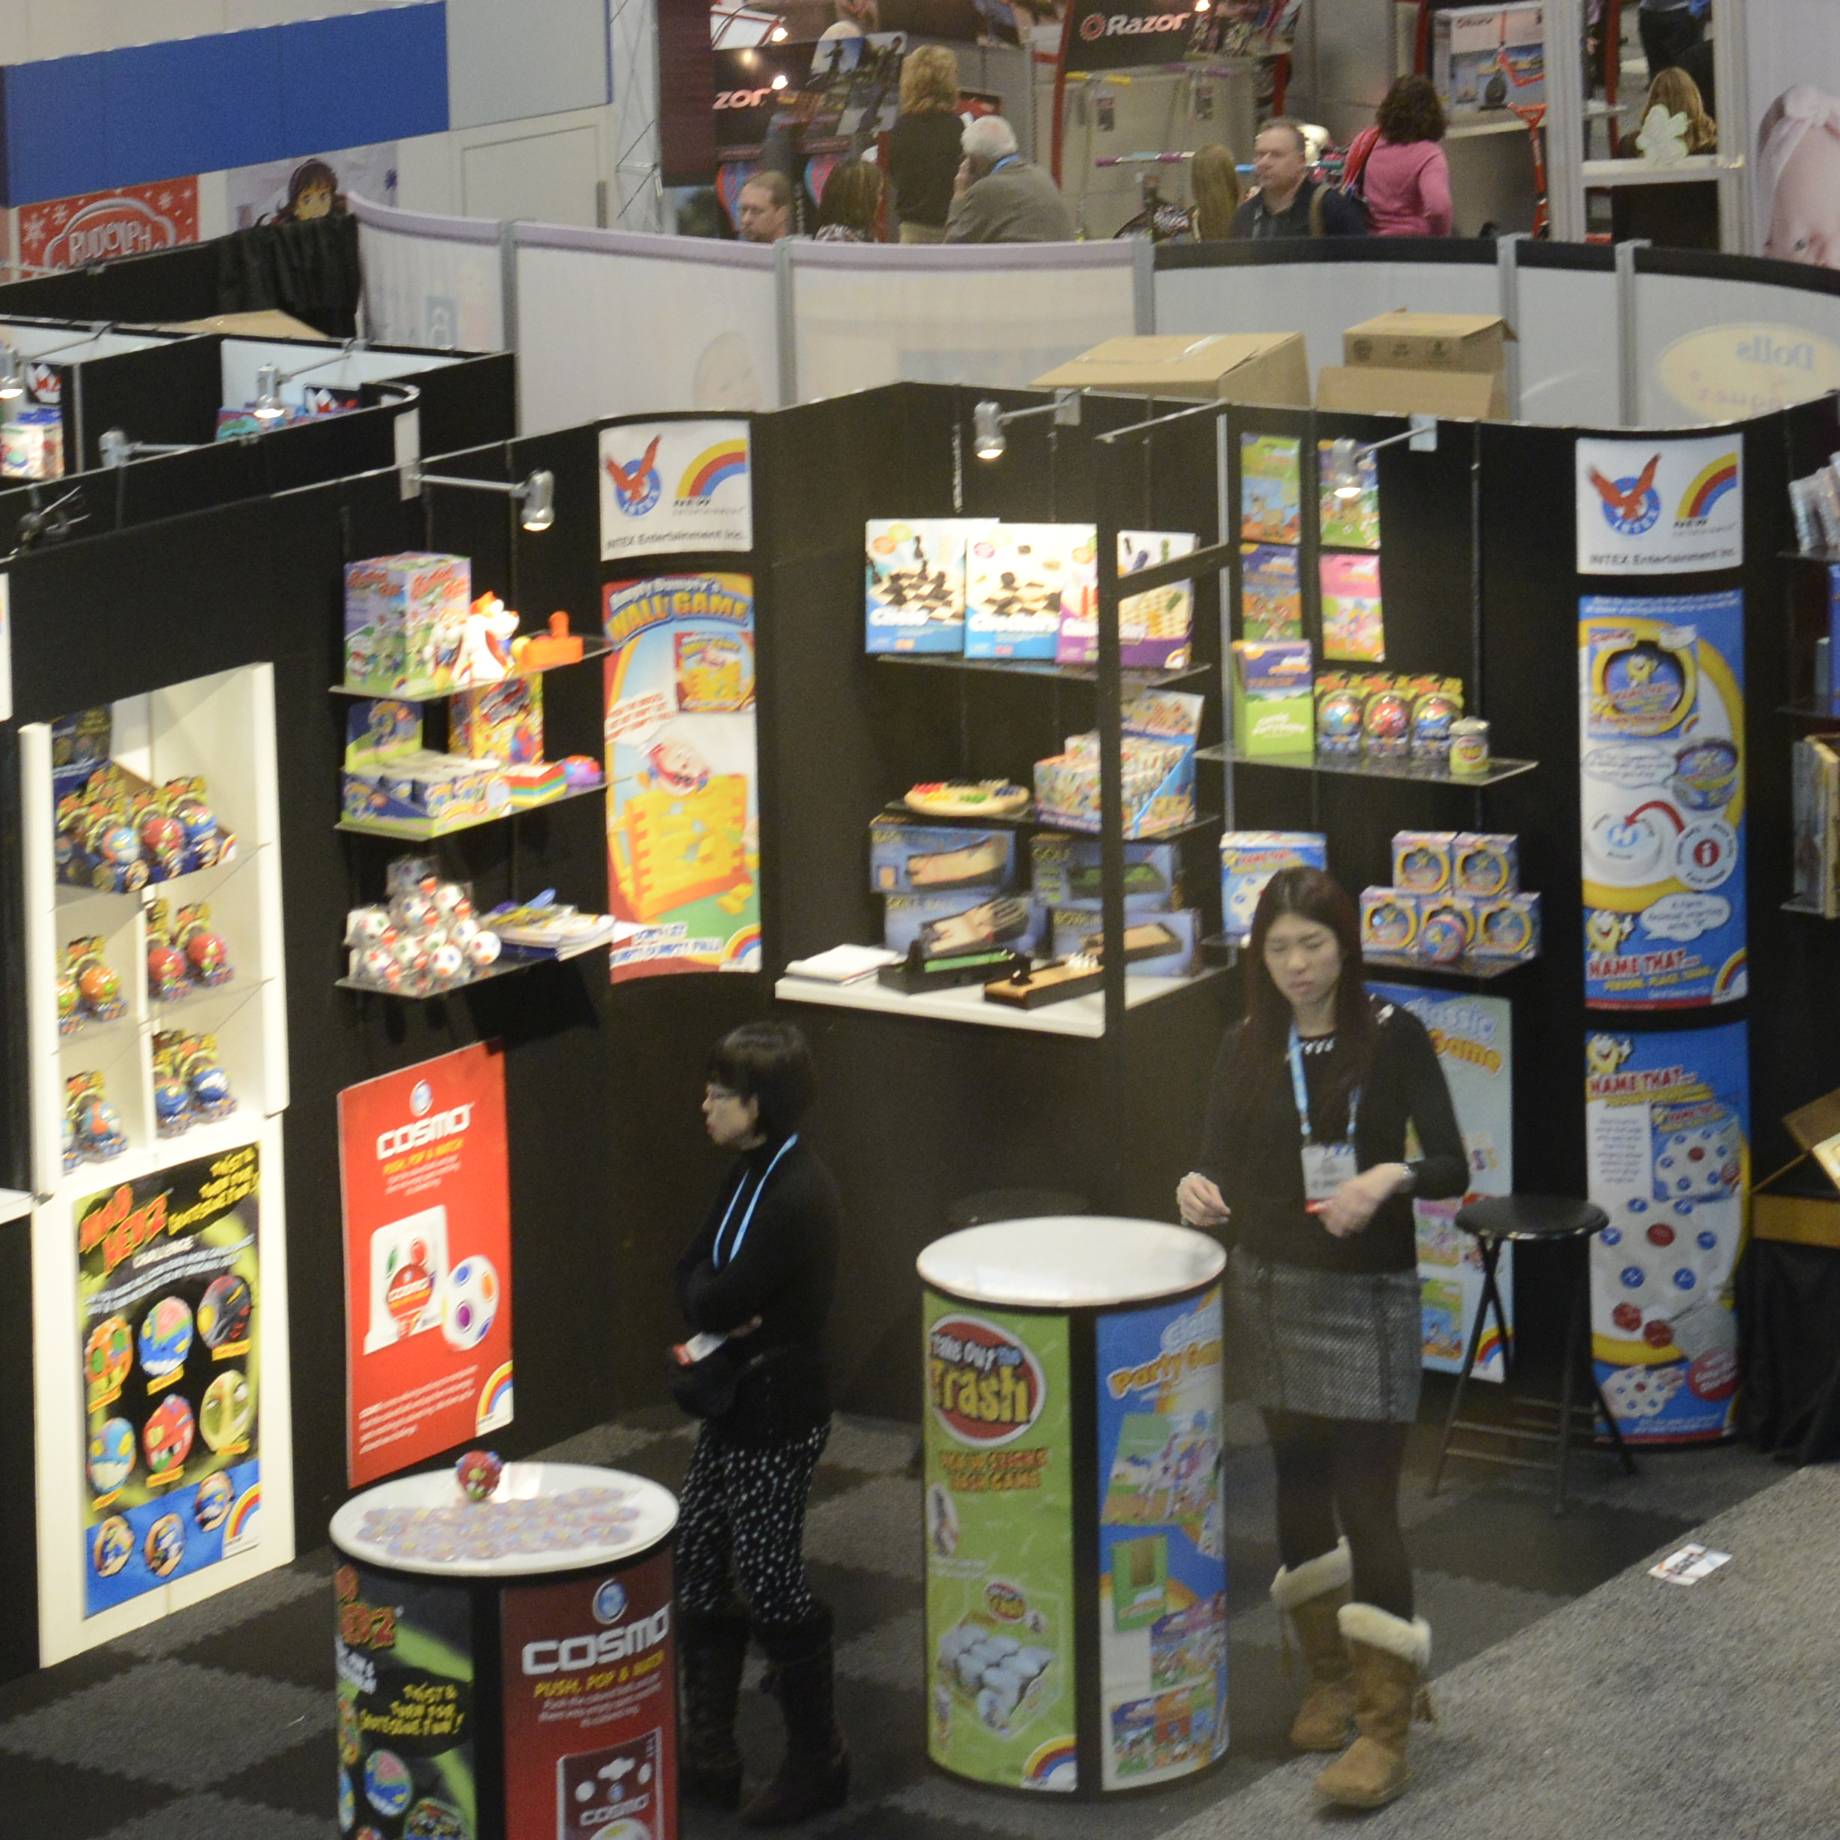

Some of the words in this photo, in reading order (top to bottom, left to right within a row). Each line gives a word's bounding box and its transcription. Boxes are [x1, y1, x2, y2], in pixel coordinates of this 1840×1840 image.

[1106, 11, 1192, 38] Razor
[69, 222, 154, 262] RUDOLPH
[672, 588, 750, 622] GAME
[1588, 956, 1640, 978] NAME
[1589, 1072, 1641, 1095] NAME
[376, 1104, 473, 1162] COSMO
[1110, 1350, 1183, 1398] Party
[521, 1603, 670, 1676] COSMO
[533, 1679, 582, 1699] PUSH,
[580, 1792, 651, 1827] COSMO
